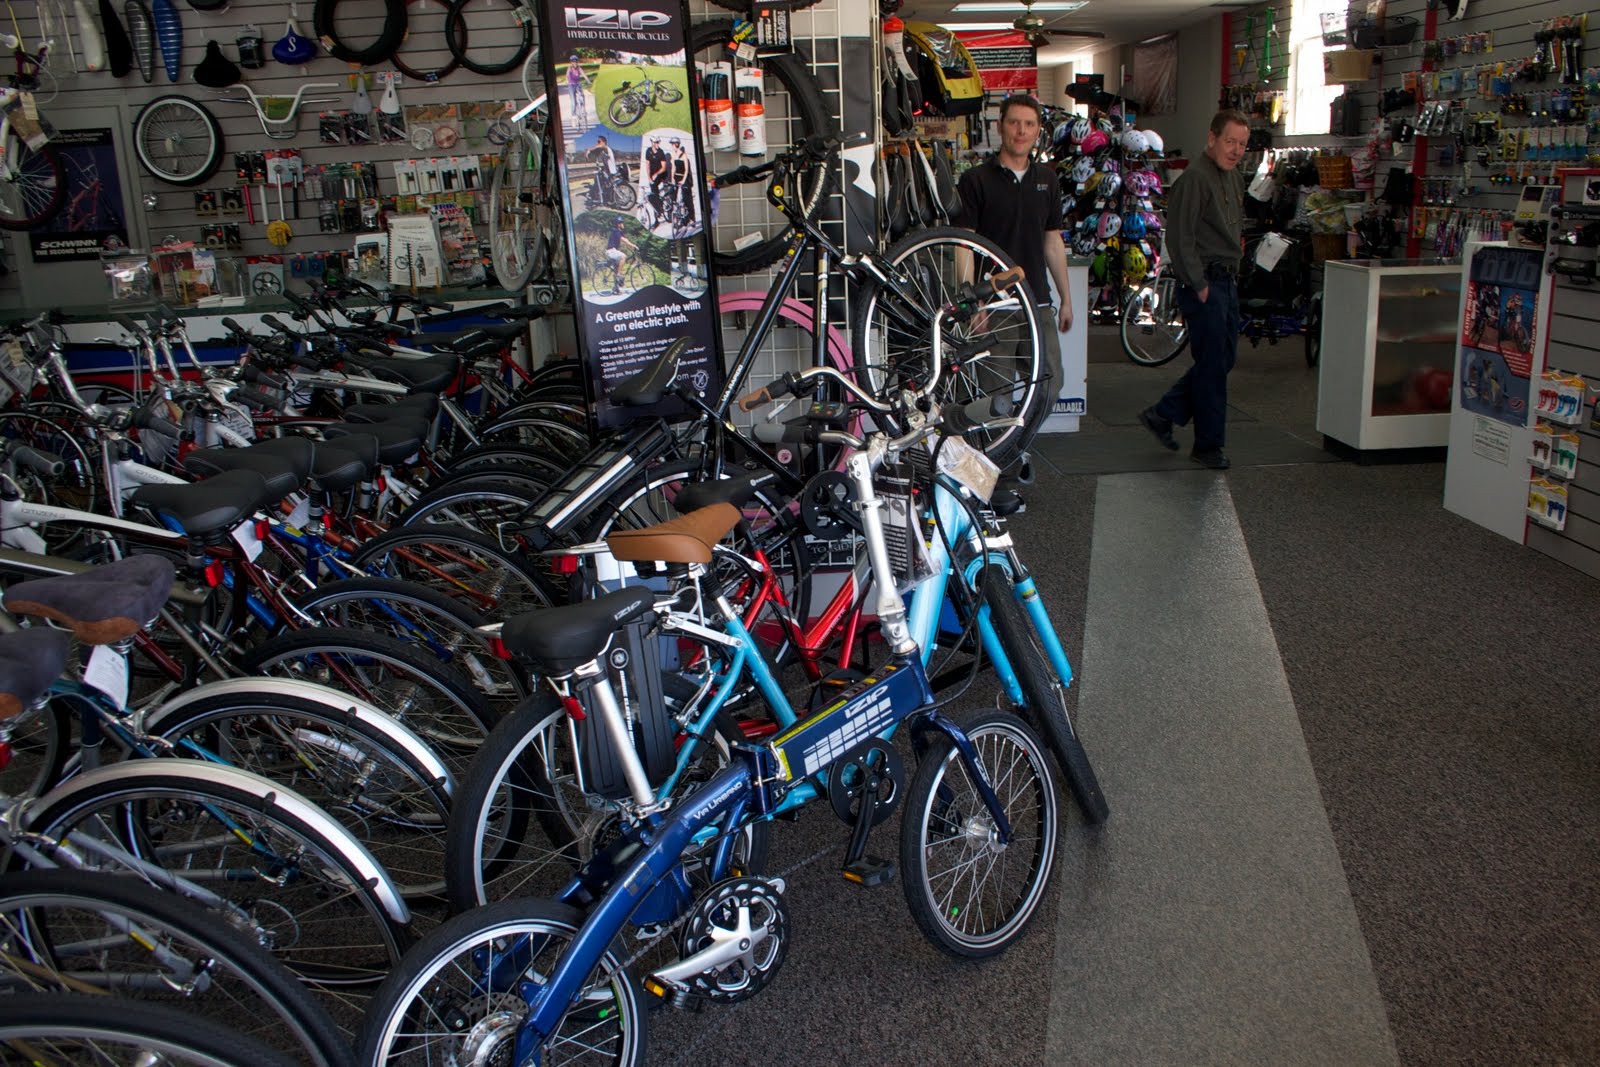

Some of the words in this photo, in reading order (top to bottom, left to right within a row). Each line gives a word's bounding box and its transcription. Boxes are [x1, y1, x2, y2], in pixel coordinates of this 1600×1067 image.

[564, 7, 671, 30] IZIP
[567, 30, 599, 39] HYBRID
[599, 31, 636, 40] ELECTRIC
[637, 32, 670, 41] BICYCLES
[39, 239, 98, 249] SCHWINN
[49, 247, 76, 255] SECOND
[595, 314, 604, 324] A
[605, 309, 645, 322] Greener
[646, 303, 682, 317] Lifestyle
[682, 299, 701, 311] with
[614, 323, 627, 333] an
[629, 317, 663, 330] electric
[665, 313, 689, 328] push.
[1051, 400, 1084, 413] VAILABLE
[614, 600, 642, 621] IZIP
[844, 684, 889, 720] IZIP
